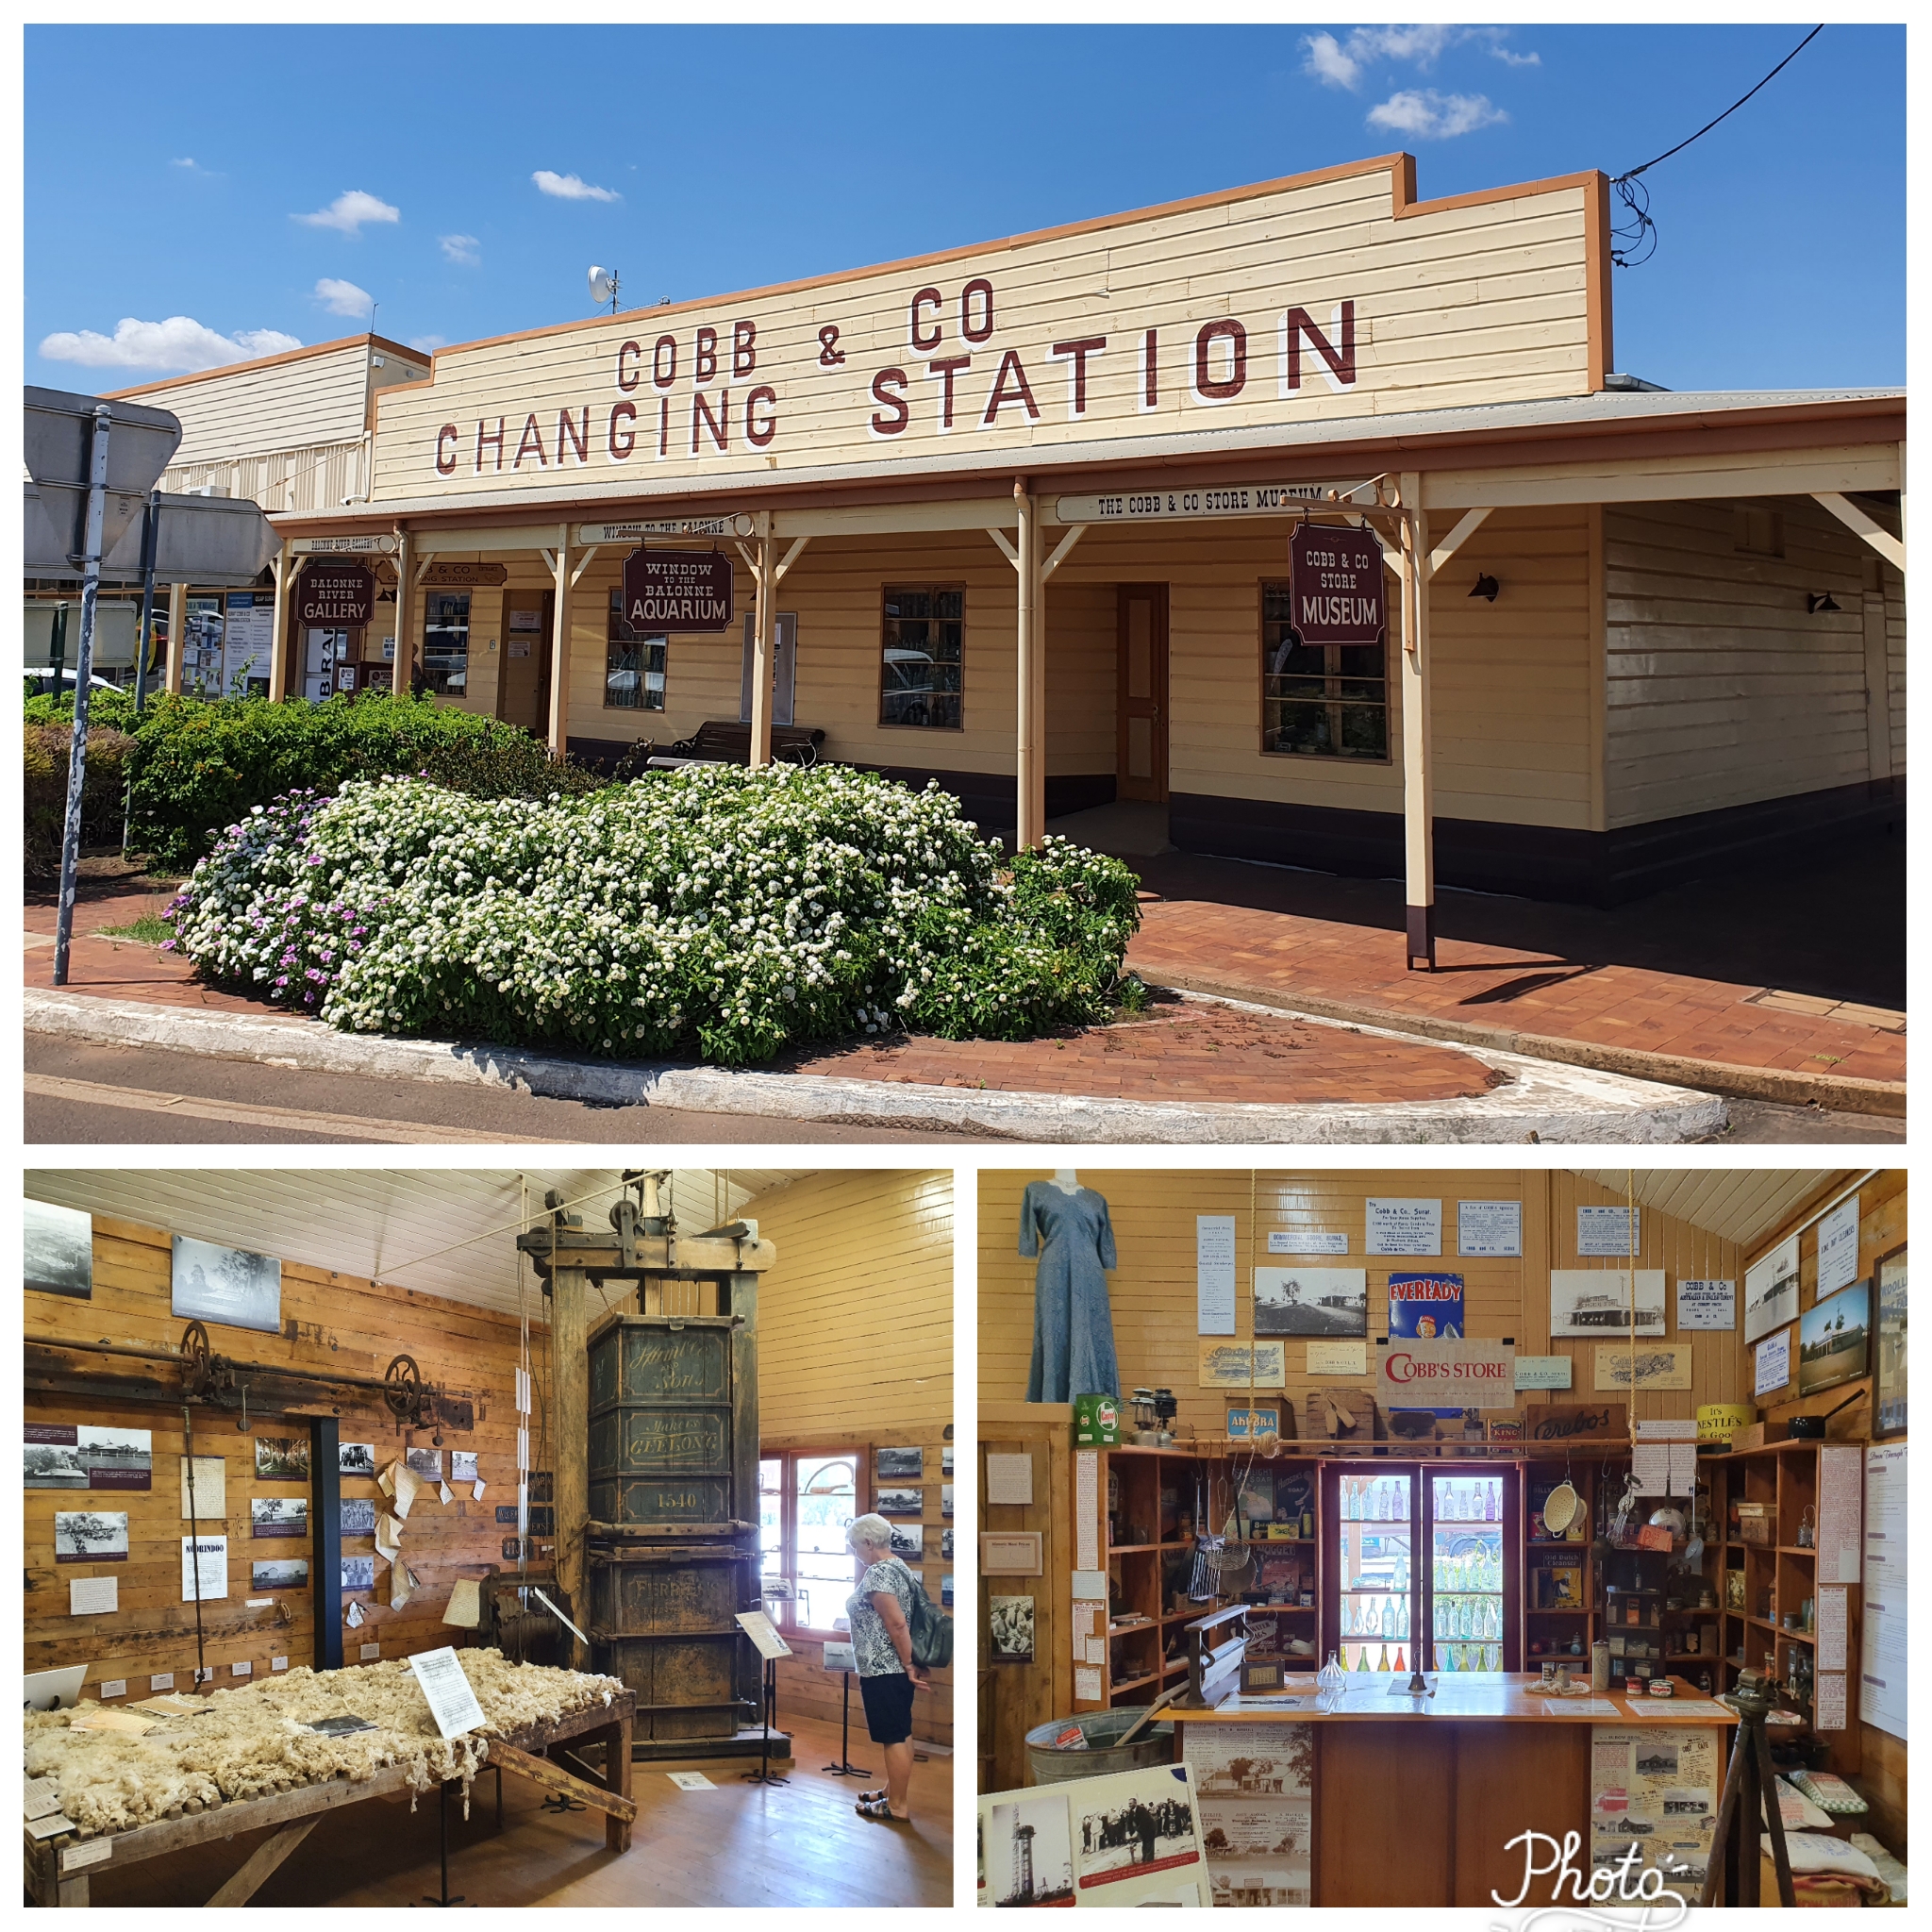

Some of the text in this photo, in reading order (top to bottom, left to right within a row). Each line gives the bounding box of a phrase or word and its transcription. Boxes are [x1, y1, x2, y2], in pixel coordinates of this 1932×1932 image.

[616, 278, 994, 395] COBB & CO
[434, 299, 1357, 477] CHANGING STATION
[1098, 497, 1123, 515] THE
[1129, 494, 1161, 514] COBB
[1168, 494, 1177, 512] &
[1183, 493, 1199, 511] CO
[1206, 491, 1249, 510] STORE
[1306, 550, 1369, 569] COBB & CO
[438, 566, 471, 575] & CO
[645, 563, 713, 575] WINDOW
[310, 578, 363, 589] BALONNE
[1320, 573, 1357, 590] STORE
[318, 590, 355, 600] RIVER
[645, 585, 714, 597] BALONNE
[304, 602, 367, 619] GALLERY
[630, 599, 726, 620] AQUARIUM
[1302, 596, 1378, 625] MUSEUM
[1390, 1278, 1462, 1302] EVEREADY
[1685, 1281, 1704, 1291] COBB
[1708, 1282, 1714, 1291] &
[1385, 1353, 1507, 1384] COBB'S STORE
[1709, 1407, 1723, 1416] It's
[1534, 1408, 1609, 1441] Cerebos
[630, 1435, 718, 1456] GEELONG
[658, 1493, 697, 1508] 1540
